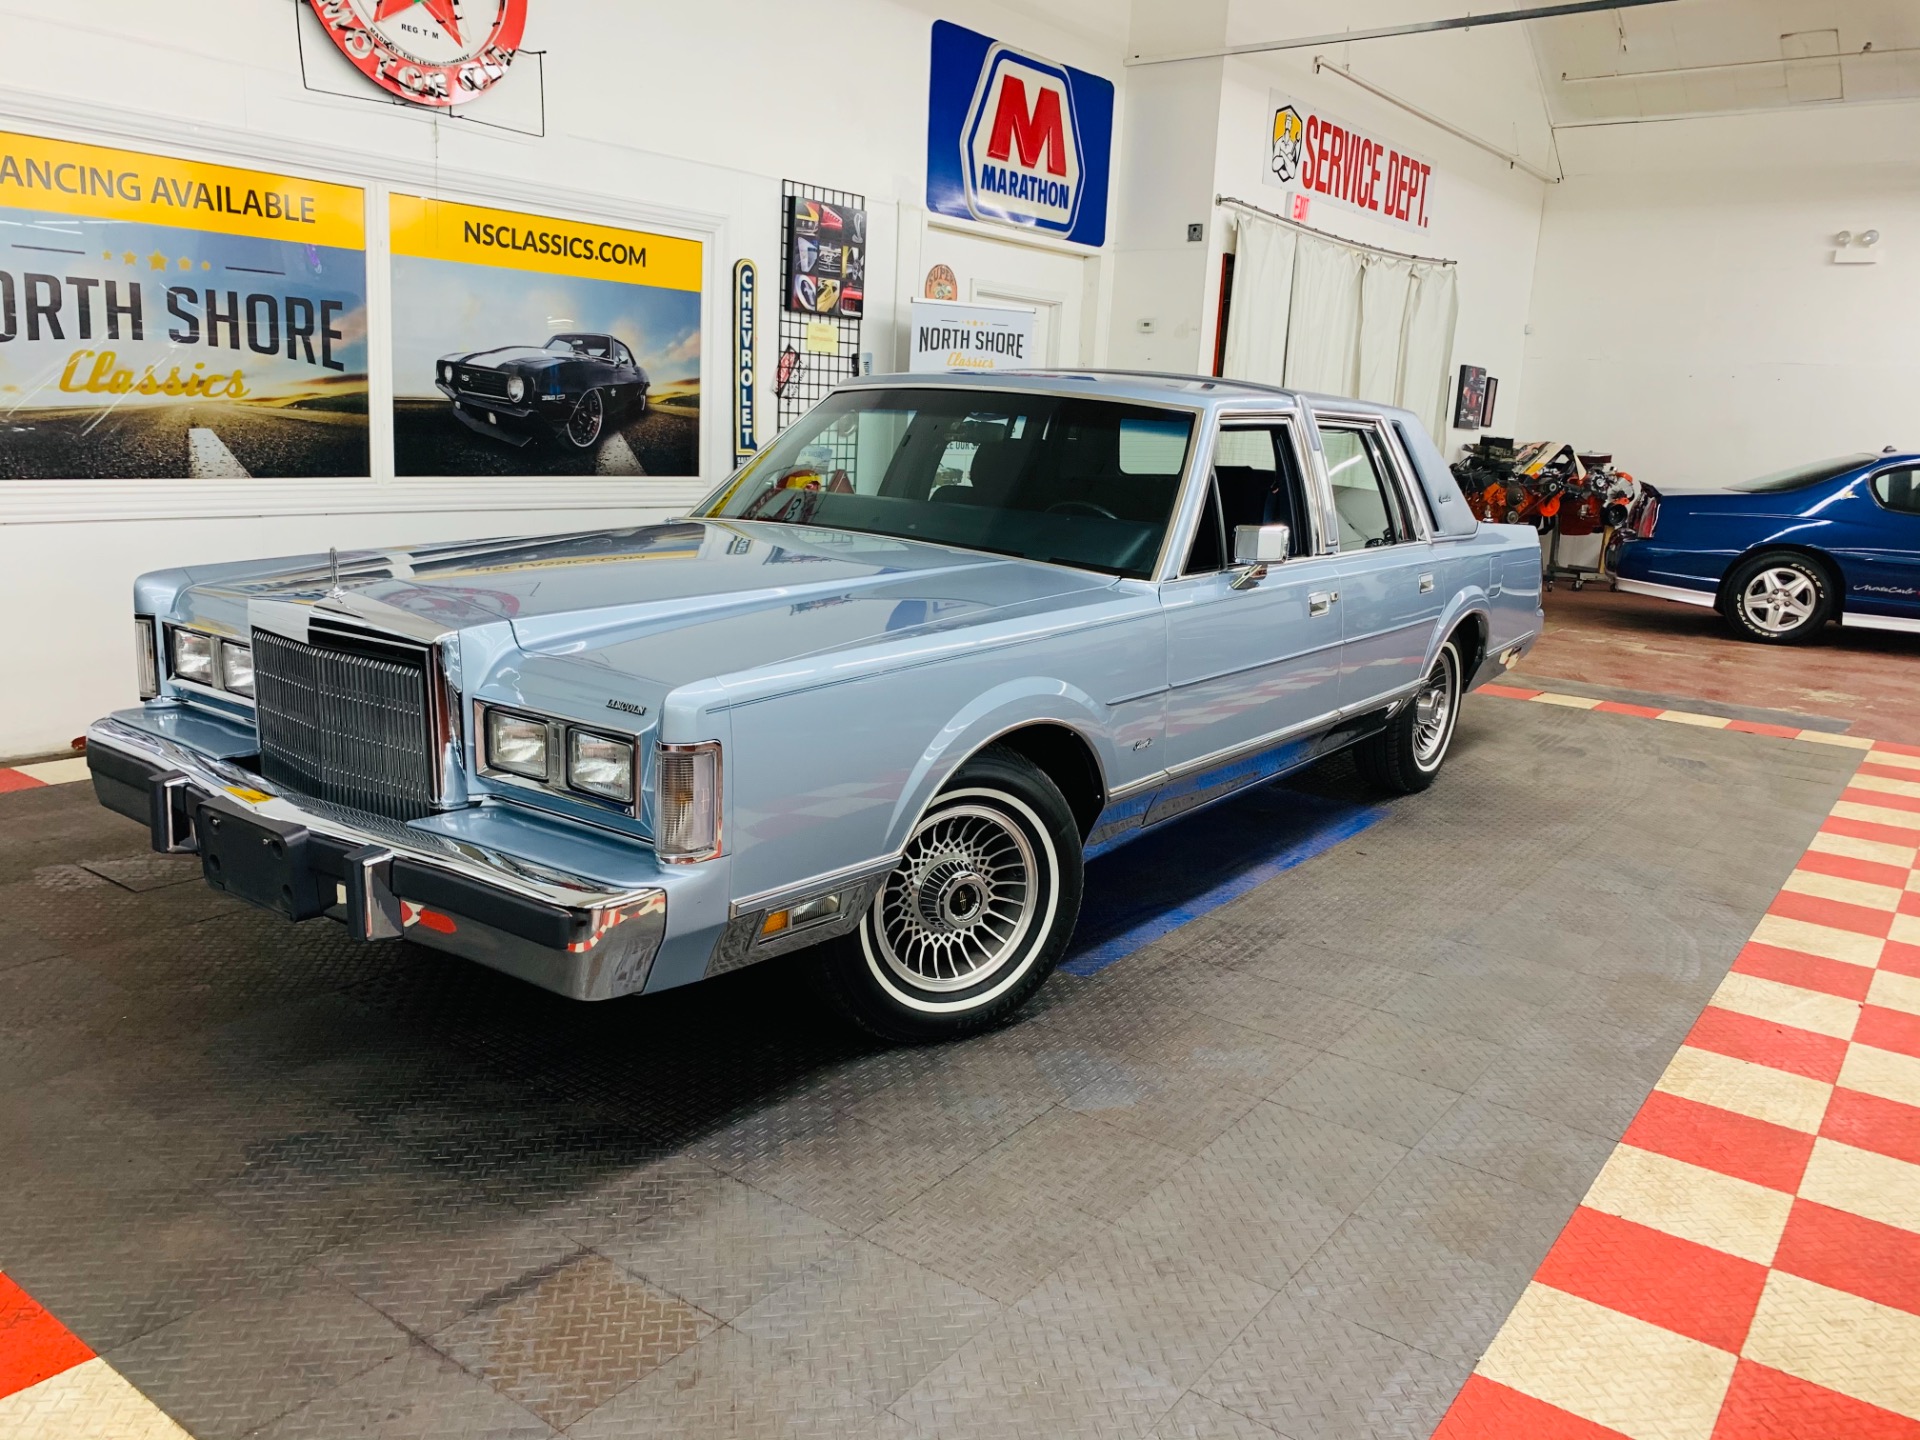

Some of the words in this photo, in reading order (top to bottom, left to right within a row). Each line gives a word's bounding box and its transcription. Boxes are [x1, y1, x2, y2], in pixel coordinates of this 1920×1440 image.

[401, 23, 418, 34] REG
[987, 74, 1067, 178] M
[0, 155, 141, 201] ANCING
[151, 177, 316, 224] AVAILABLE
[981, 164, 1070, 209] MARATHON
[1302, 115, 1384, 211] SERVICE
[1384, 150, 1431, 228] DEPT.
[1293, 194, 1310, 222] EXIT
[464, 221, 646, 268] NSCLASSICS.COM
[166, 286, 345, 373] SHORE
[919, 326, 970, 353] NORTH
[975, 331, 1025, 359] SHORE
[59, 349, 252, 399] Classics
[741, 270, 753, 446] CHEVROLET
[946, 351, 995, 369] Classics
[606, 699, 647, 716] LINCOLN
